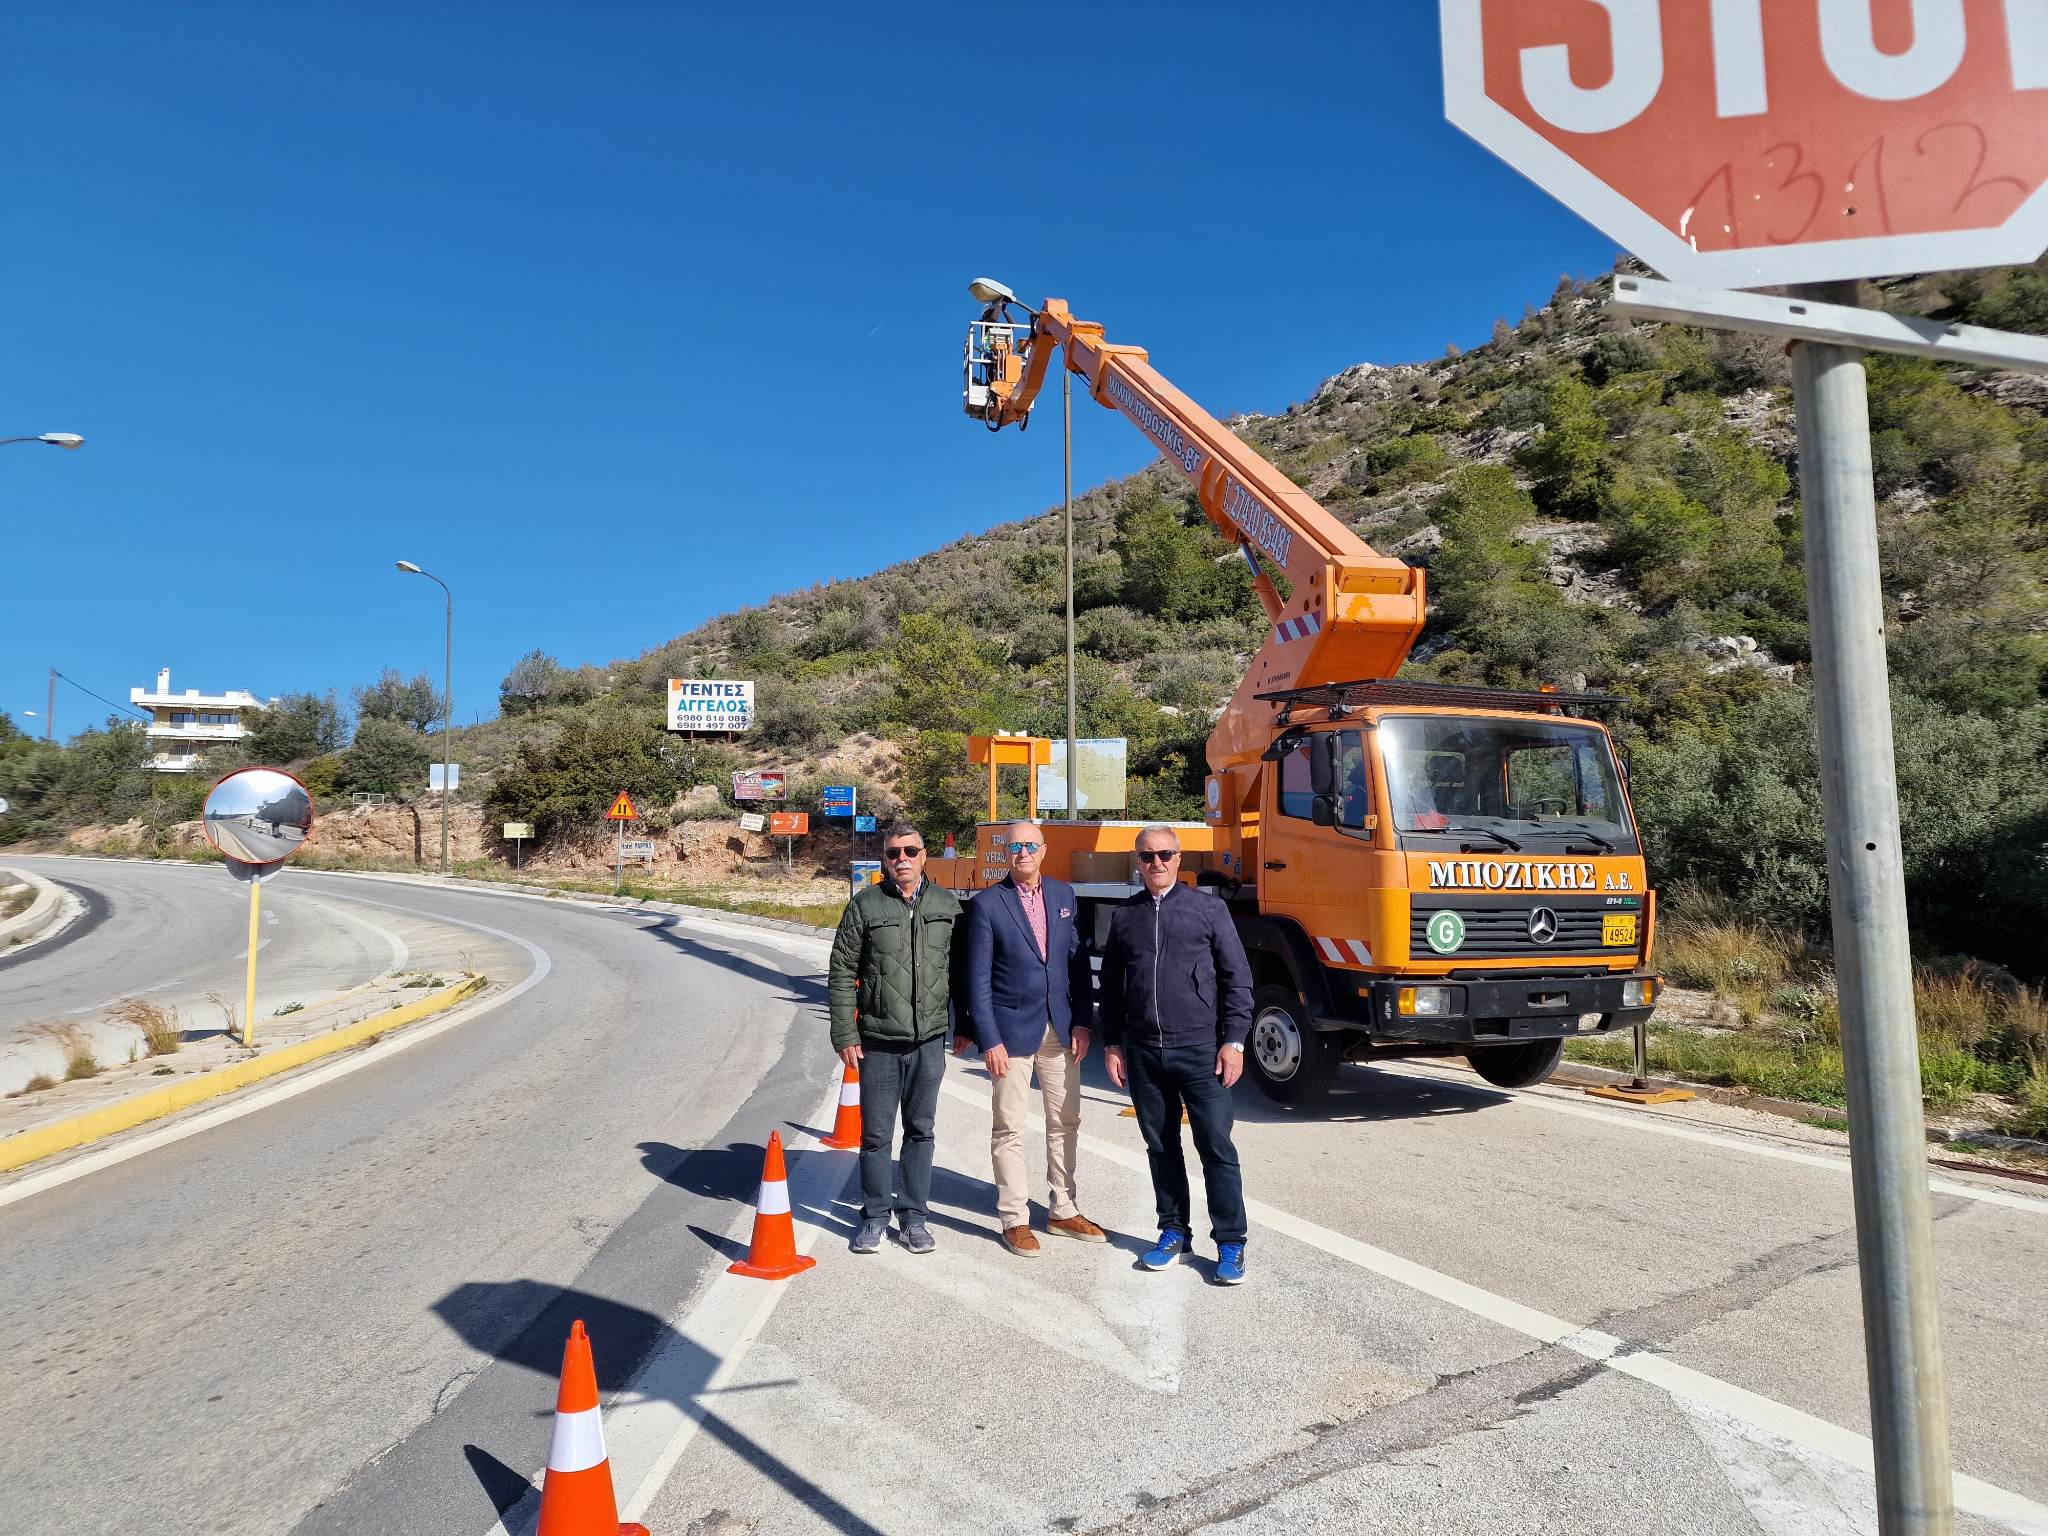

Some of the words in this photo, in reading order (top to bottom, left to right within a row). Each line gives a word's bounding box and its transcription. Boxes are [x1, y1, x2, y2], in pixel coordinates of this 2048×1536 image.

[1686, 120, 2031, 250] 1312
[1108, 374, 1200, 472] www.mpozikis.gr
[1231, 484, 1261, 537] 27410
[1259, 511, 1292, 569] 85481
[680, 683, 744, 697] ΤΕΝΤΕΣ
[678, 699, 747, 713] ΑΓΓΕΛΟΣ
[735, 773, 762, 784] Cave
[985, 851, 1006, 864] ΜΕΤΑΦ
[1427, 861, 1597, 890] ΜΠΟΖΙΚΗΣ
[1604, 872, 1634, 890] Α.Ε.
[1439, 920, 1454, 943] G
[1605, 929, 1634, 943] 149524
